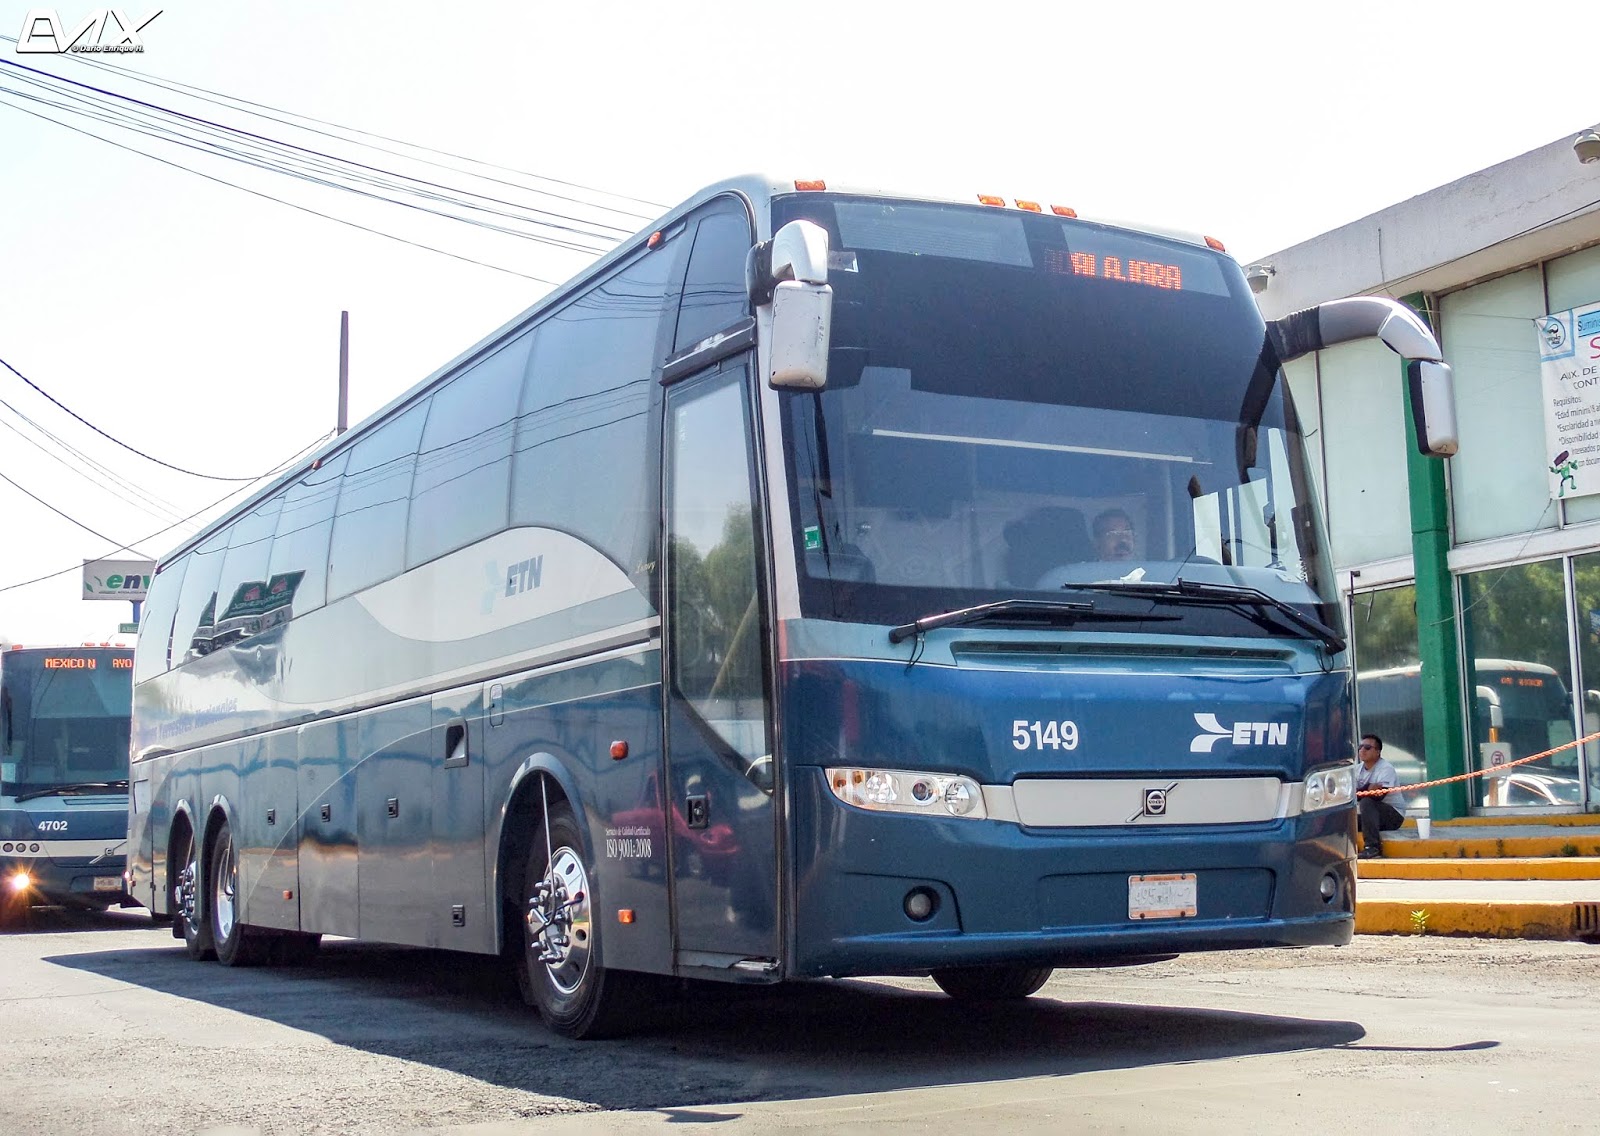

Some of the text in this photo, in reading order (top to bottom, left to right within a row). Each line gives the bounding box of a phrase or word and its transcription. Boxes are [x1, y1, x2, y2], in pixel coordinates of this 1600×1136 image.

[1582, 366, 1598, 376] DE
[505, 555, 544, 598] ETN
[45, 658, 85, 669] MEXICO
[87, 658, 96, 670] N
[1012, 720, 1079, 750] 5149
[1232, 722, 1289, 746] ETN
[38, 820, 68, 831] 4702
[606, 838, 652, 861] ISO 9001:2008
